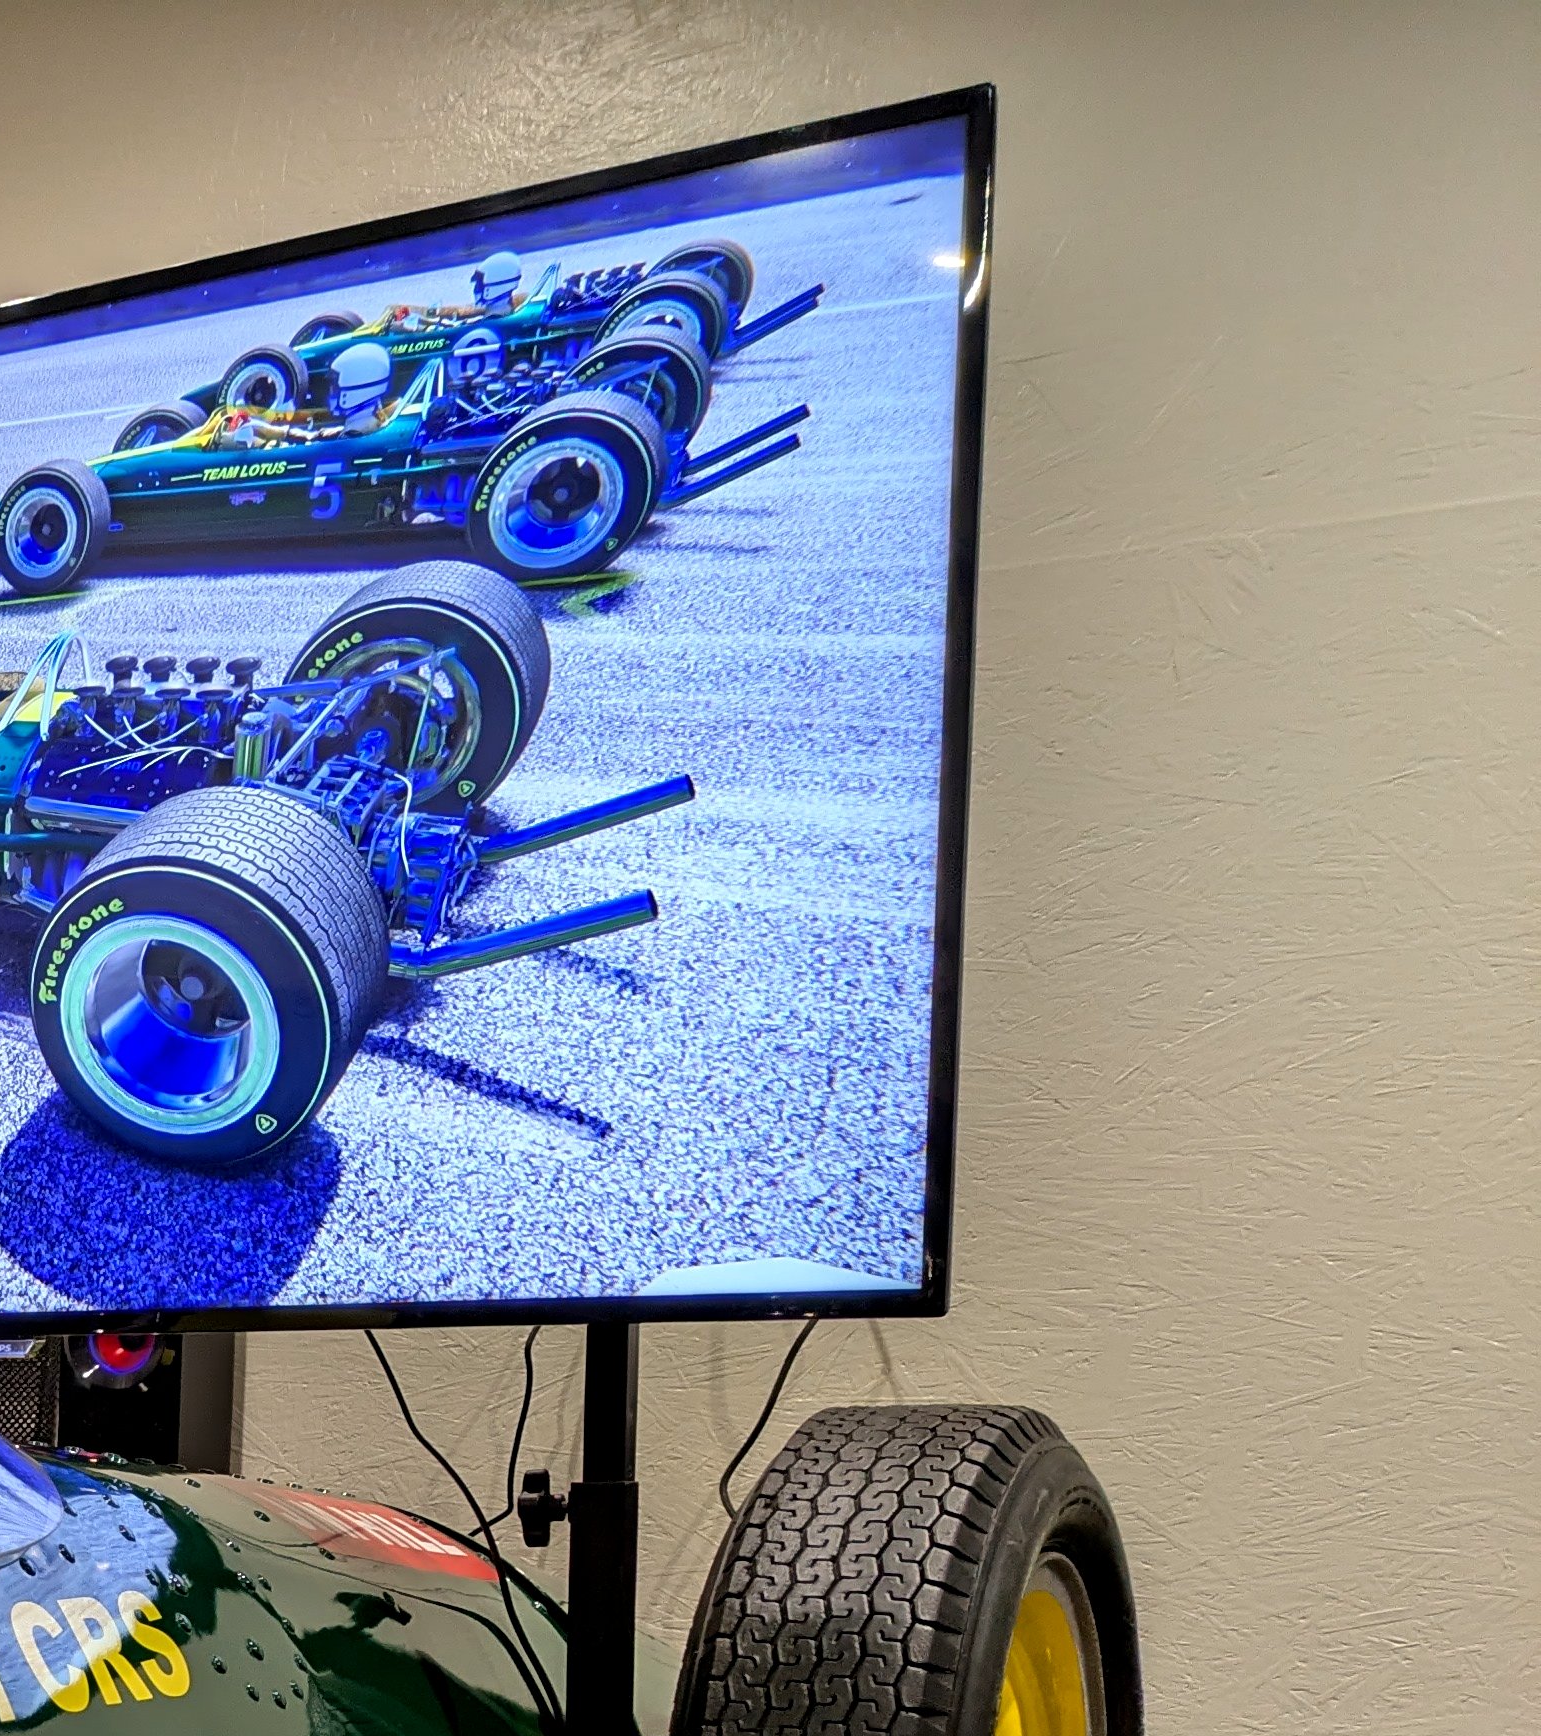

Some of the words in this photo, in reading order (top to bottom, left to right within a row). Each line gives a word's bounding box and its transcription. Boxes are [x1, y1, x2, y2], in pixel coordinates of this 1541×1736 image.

[388, 344, 408, 355] AM
[408, 339, 446, 352] LOTUS
[202, 467, 238, 482] TEAM
[239, 461, 288, 478] LOTUS
[310, 462, 342, 519] 5
[474, 436, 537, 512] Firestone
[307, 631, 365, 679] stone
[38, 898, 124, 1005] Firestone
[11, 1590, 191, 1714] CRS
